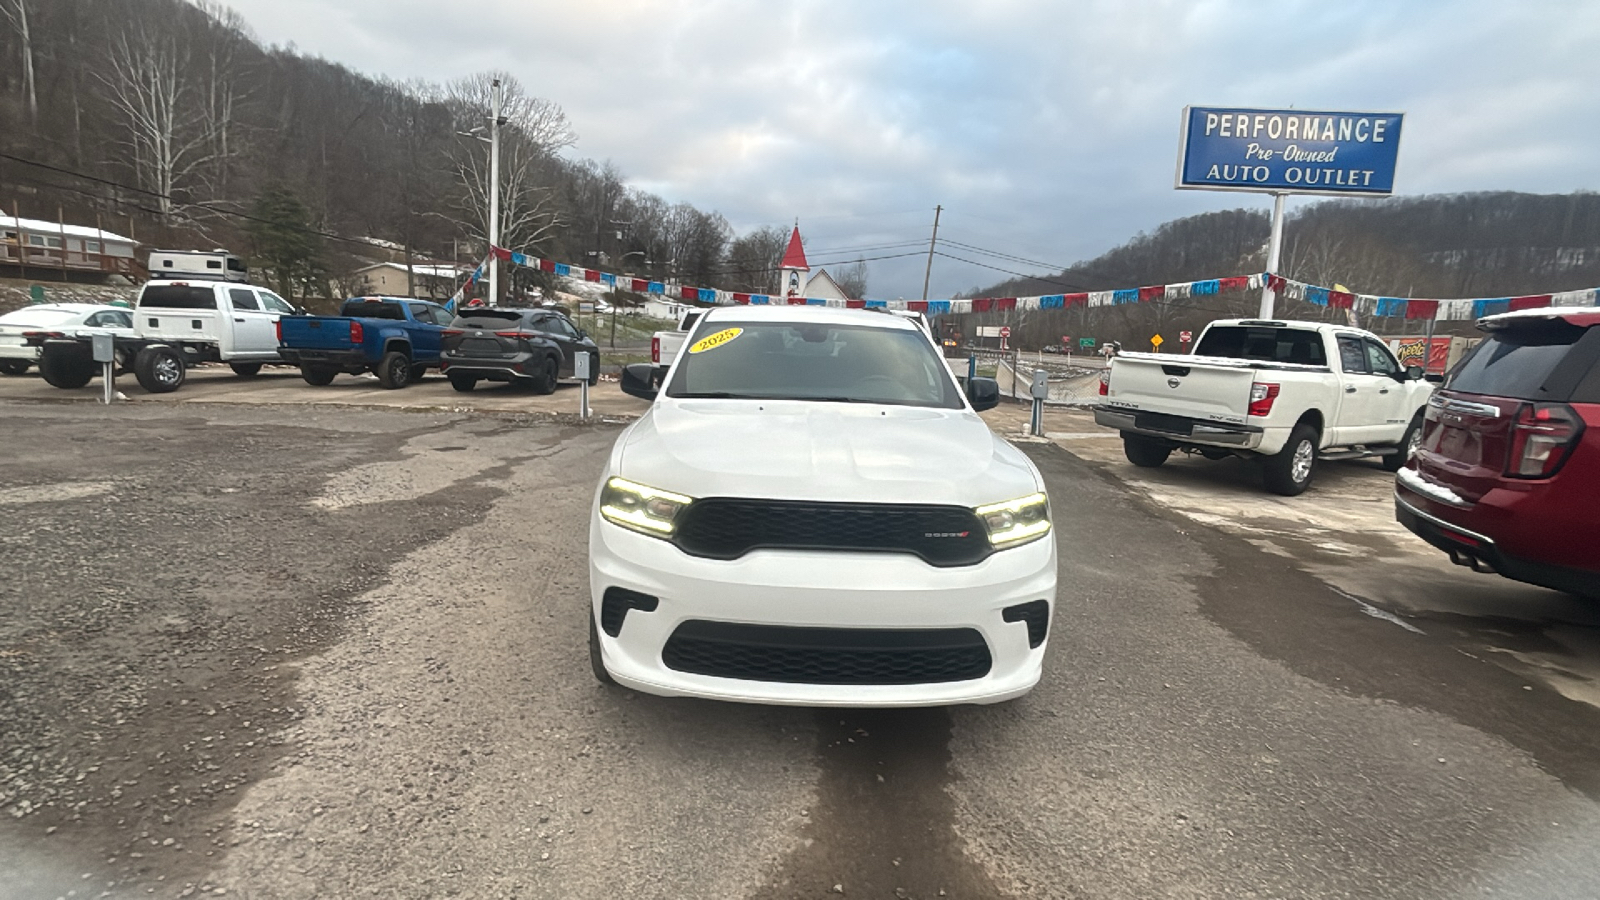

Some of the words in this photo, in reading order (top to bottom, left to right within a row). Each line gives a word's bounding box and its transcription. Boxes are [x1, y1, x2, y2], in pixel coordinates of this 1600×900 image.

[1205, 113, 1388, 143] PERFORMANCE
[1245, 143, 1339, 163] Pre-Owned
[1206, 164, 1270, 182] AUTO
[1284, 167, 1375, 186] OUTLET
[699, 330, 734, 350] 2025
